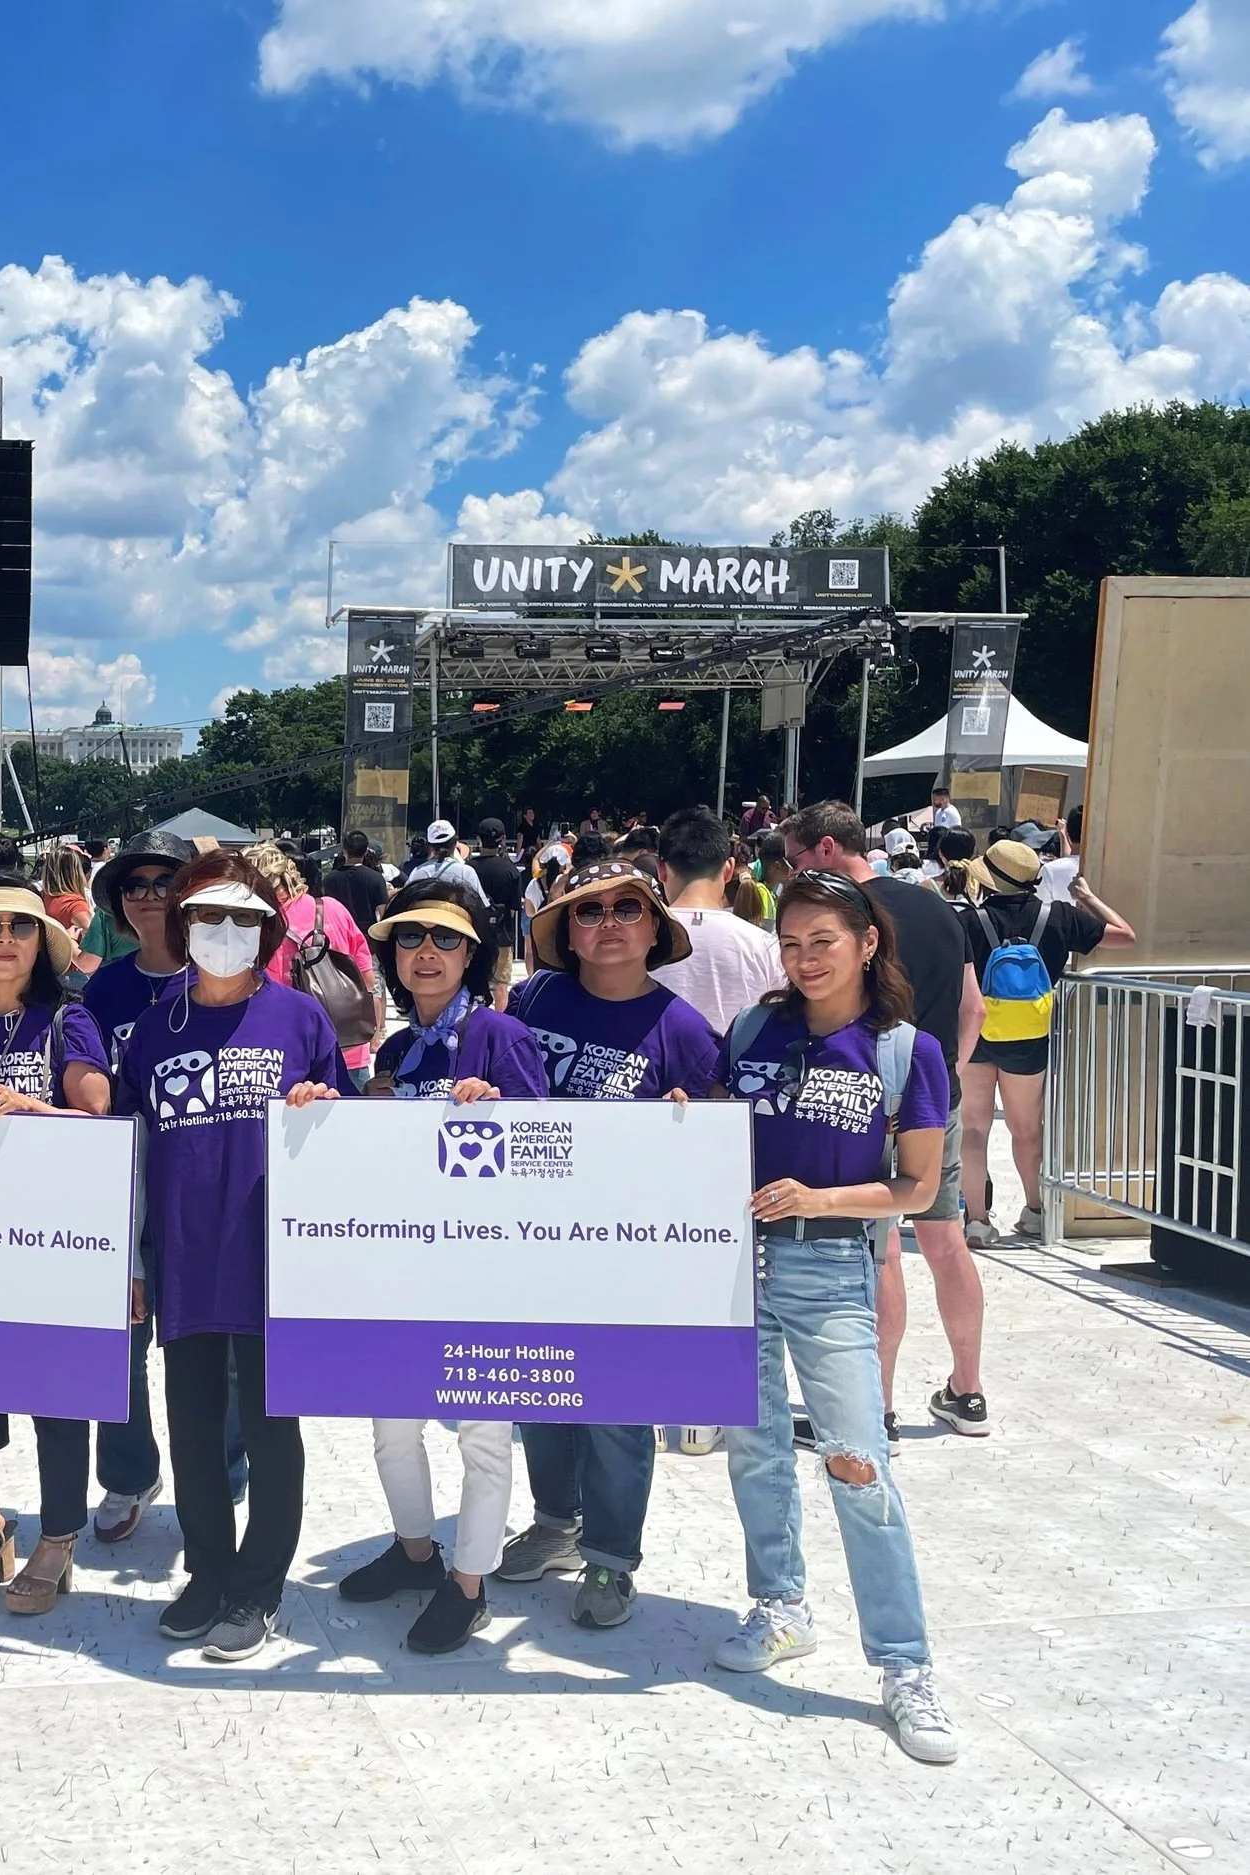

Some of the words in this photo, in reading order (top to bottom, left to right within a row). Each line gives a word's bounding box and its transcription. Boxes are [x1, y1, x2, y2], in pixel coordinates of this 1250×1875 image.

[473, 556, 594, 593] UNITY
[659, 557, 791, 595] MARCH
[352, 664, 379, 674] UNITY
[380, 665, 410, 674] MARCH
[954, 669, 980, 679] UNITY
[980, 669, 1009, 679] MARCH
[218, 1048, 284, 1063] KOREAN
[582, 1042, 649, 1070] KOREAN
[218, 1061, 283, 1075] AMERICAN
[577, 1055, 644, 1080] AMERICAN
[218, 1071, 282, 1089] FAMILY
[419, 1078, 455, 1093] KORE
[572, 1064, 641, 1091] FAMILY
[808, 1067, 884, 1091] KOREAN
[219, 1086, 248, 1097] SERVICE
[249, 1085, 281, 1097] CENTER
[569, 1076, 603, 1090] SERVICE
[602, 1084, 635, 1099] CENTER
[804, 1080, 882, 1102] AMERICAN
[219, 1094, 265, 1108] 뉴욕가정상
[799, 1089, 878, 1116] FAMILY
[794, 1109, 868, 1134] 뉴욕가정상담소
[795, 1101, 838, 1114] SERVICE
[838, 1107, 872, 1125] CENTER
[158, 1121, 170, 1132] 24
[179, 1114, 214, 1127] Hotline
[510, 1121, 572, 1134] KOREAN
[510, 1134, 572, 1145] AMERICAN
[510, 1145, 574, 1160] FAMILY
[510, 1168, 574, 1179] 뉴욕가정상담소
[9, 1228, 45, 1248] Not
[50, 1230, 117, 1252] Alone.
[282, 1217, 436, 1245] Transforming
[443, 1219, 510, 1242] Lives.
[517, 1221, 561, 1242] You
[568, 1222, 609, 1243] Are
[616, 1223, 657, 1243] Not
[664, 1223, 738, 1244] Alone.
[443, 1344, 511, 1360] 24-Hour
[516, 1346, 575, 1361] Hotline
[443, 1367, 575, 1384] 718-460-3800
[435, 1389, 584, 1408] WWW.KAFSC.ORG
